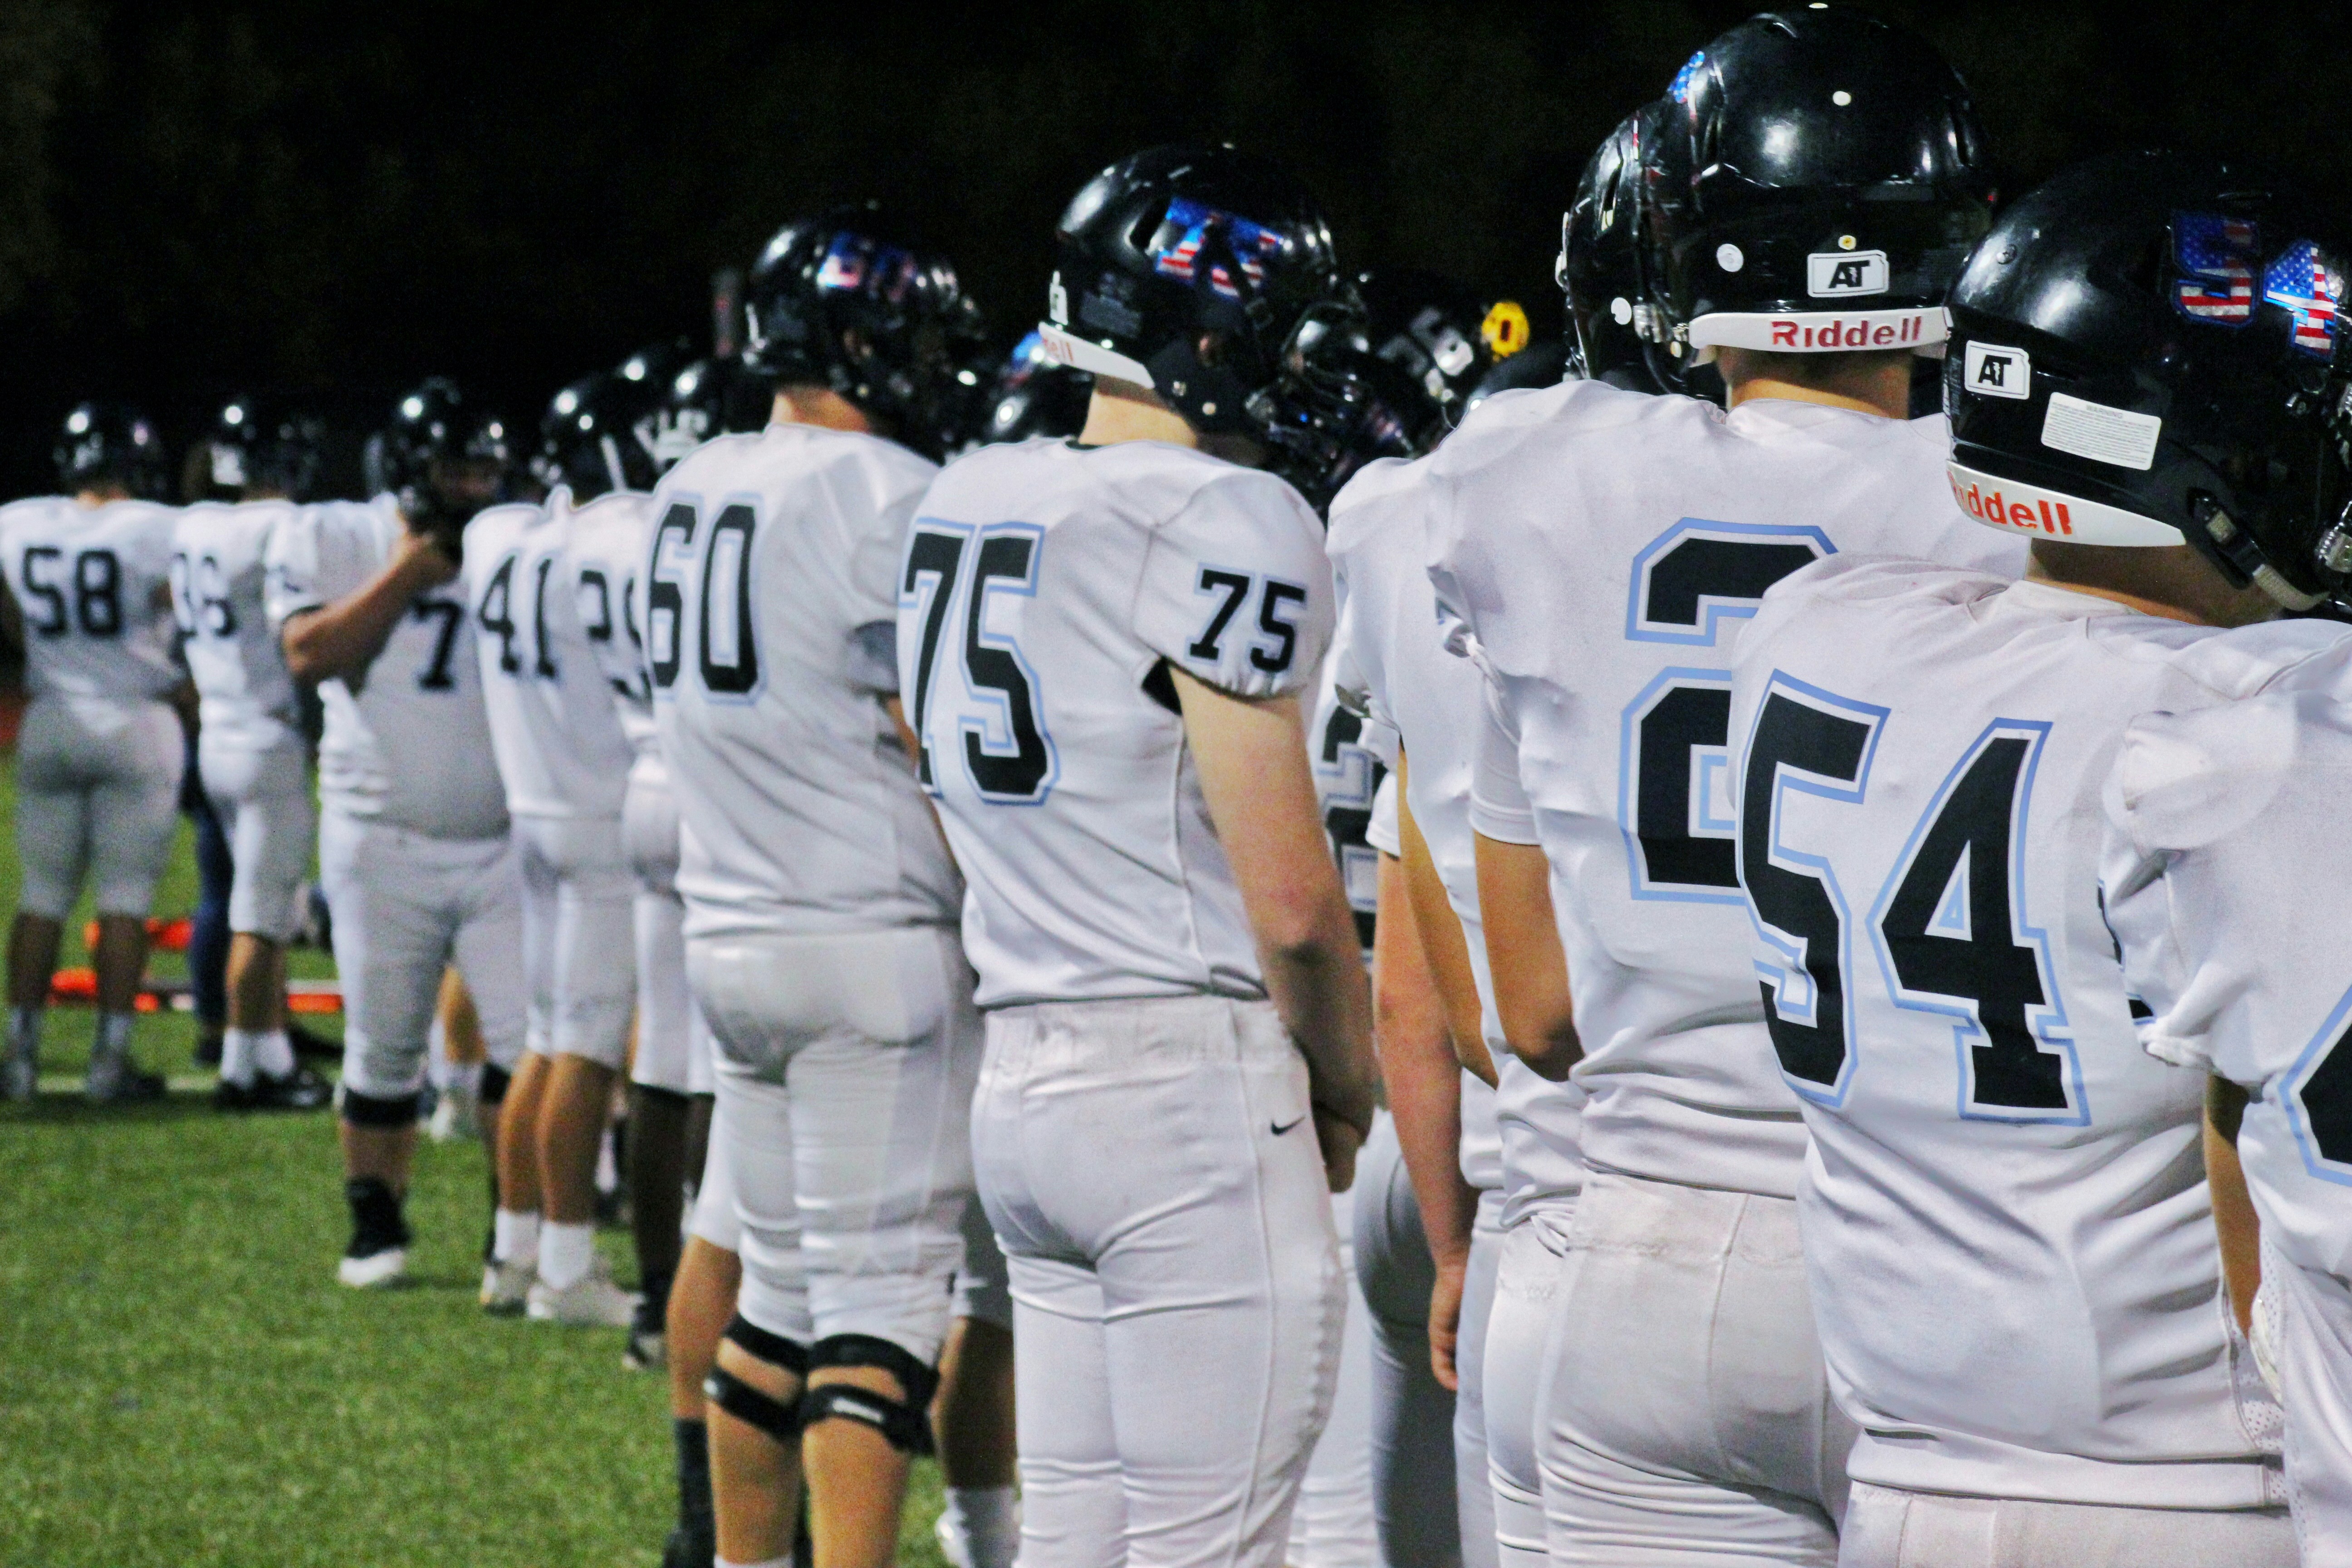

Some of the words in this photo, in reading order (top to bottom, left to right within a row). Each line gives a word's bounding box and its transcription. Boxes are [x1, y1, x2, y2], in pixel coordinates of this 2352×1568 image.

[1771, 316, 1923, 348] Riddell
[1828, 260, 1871, 289] AT
[2172, 210, 2337, 362] 54
[1977, 354, 2012, 387] AT
[23, 545, 122, 639] 58
[475, 550, 559, 681] 41
[648, 491, 768, 706] 60
[1184, 562, 1308, 677] 75
[899, 516, 1061, 807] 75
[1735, 668, 2092, 1127] 54
